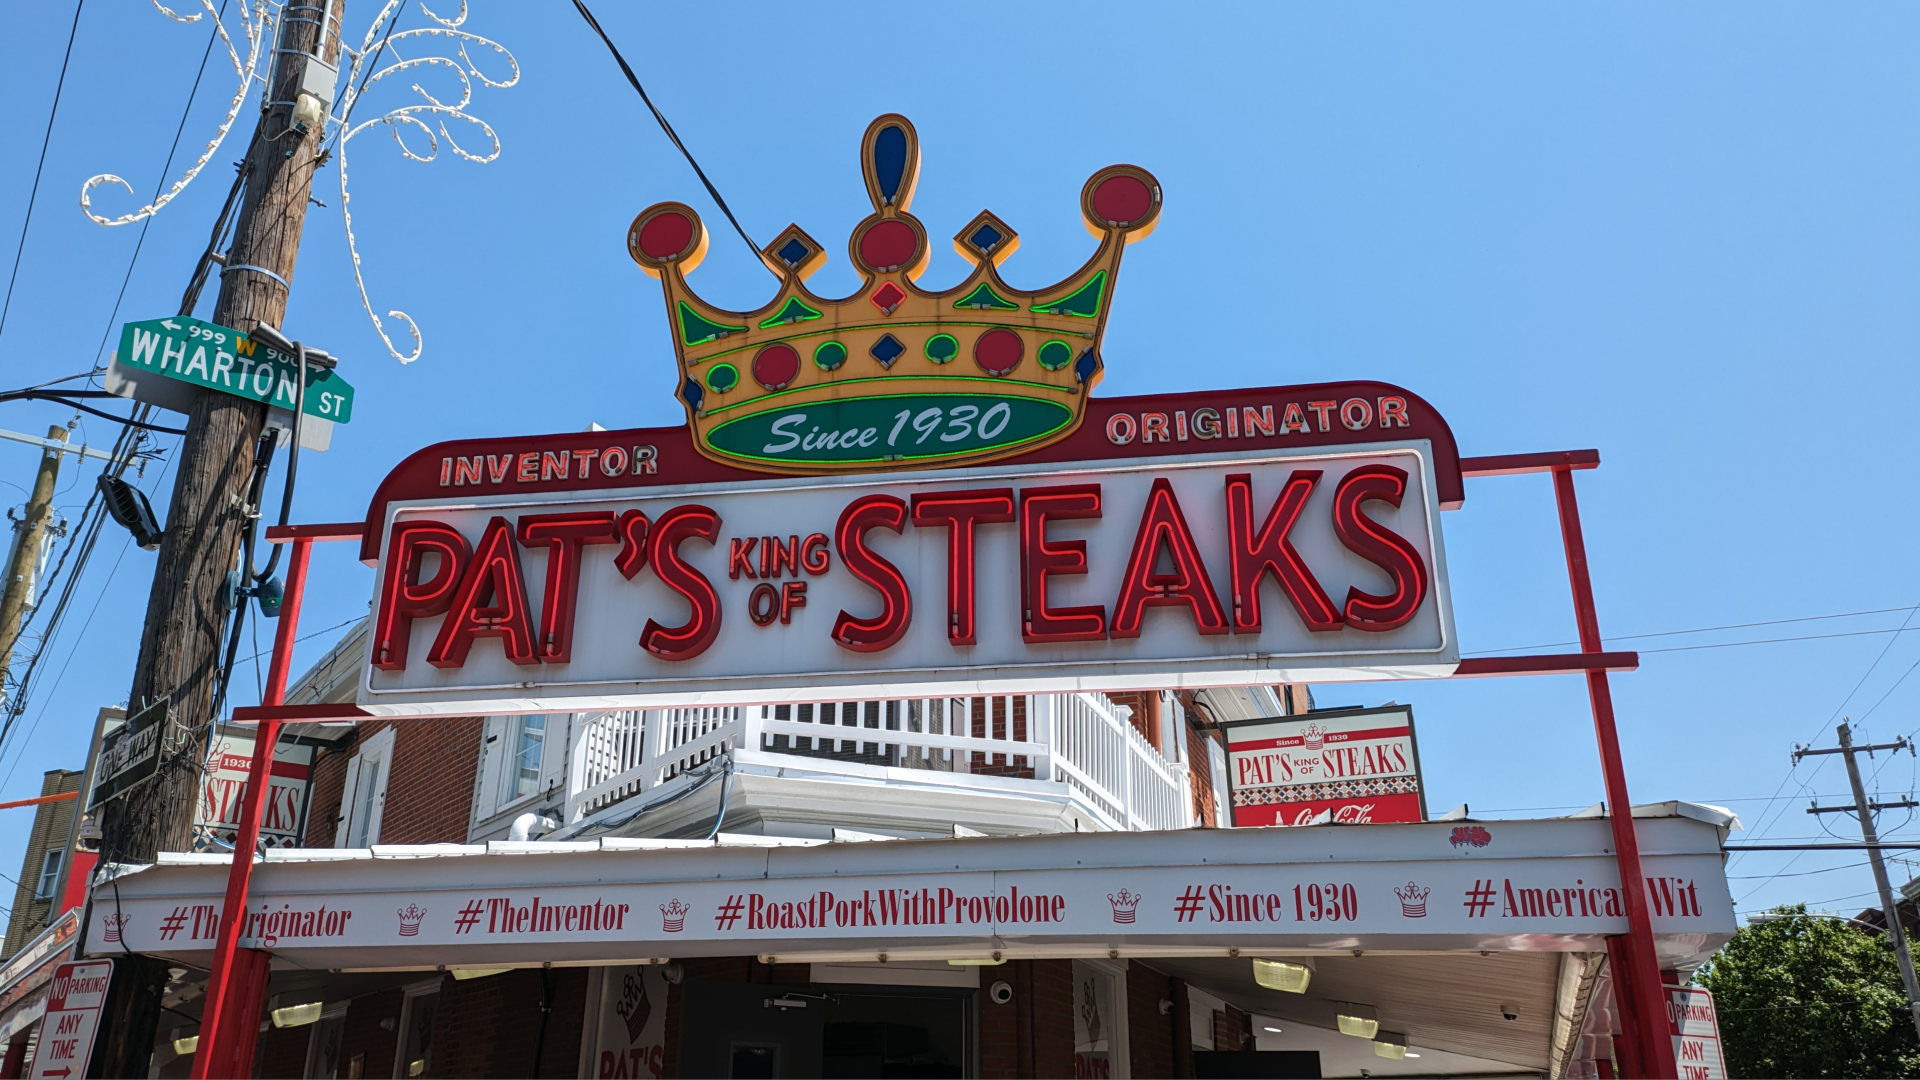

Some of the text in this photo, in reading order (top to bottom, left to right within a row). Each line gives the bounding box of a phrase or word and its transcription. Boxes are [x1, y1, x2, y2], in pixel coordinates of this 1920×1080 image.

[188, 325, 227, 345] 999
[236, 336, 258, 357] W
[131, 327, 345, 417] WHARTON ST
[762, 402, 1011, 453] Since 1930
[1106, 396, 1412, 445] ORIGINATOR
[439, 445, 659, 487] INVENTOR
[371, 464, 1428, 671] PAT'S KING OF STEAKS
[127, 728, 157, 767] WAY
[1276, 733, 1348, 747] Since 1930
[1237, 742, 1407, 786] PAT'S KING OF STEAKS
[454, 897, 629, 934] #TheInventor
[714, 886, 1066, 931] #RoastPorkWithProvolone
[1173, 882, 1358, 923] #Since 1930
[159, 903, 352, 948] #Thriginator
[51, 976, 106, 1000] NO PARKING
[55, 1014, 84, 1035] ANY
[1675, 1003, 1712, 1022] PARKING
[50, 1039, 79, 1060] TIME
[1682, 1040, 1704, 1061] ANY
